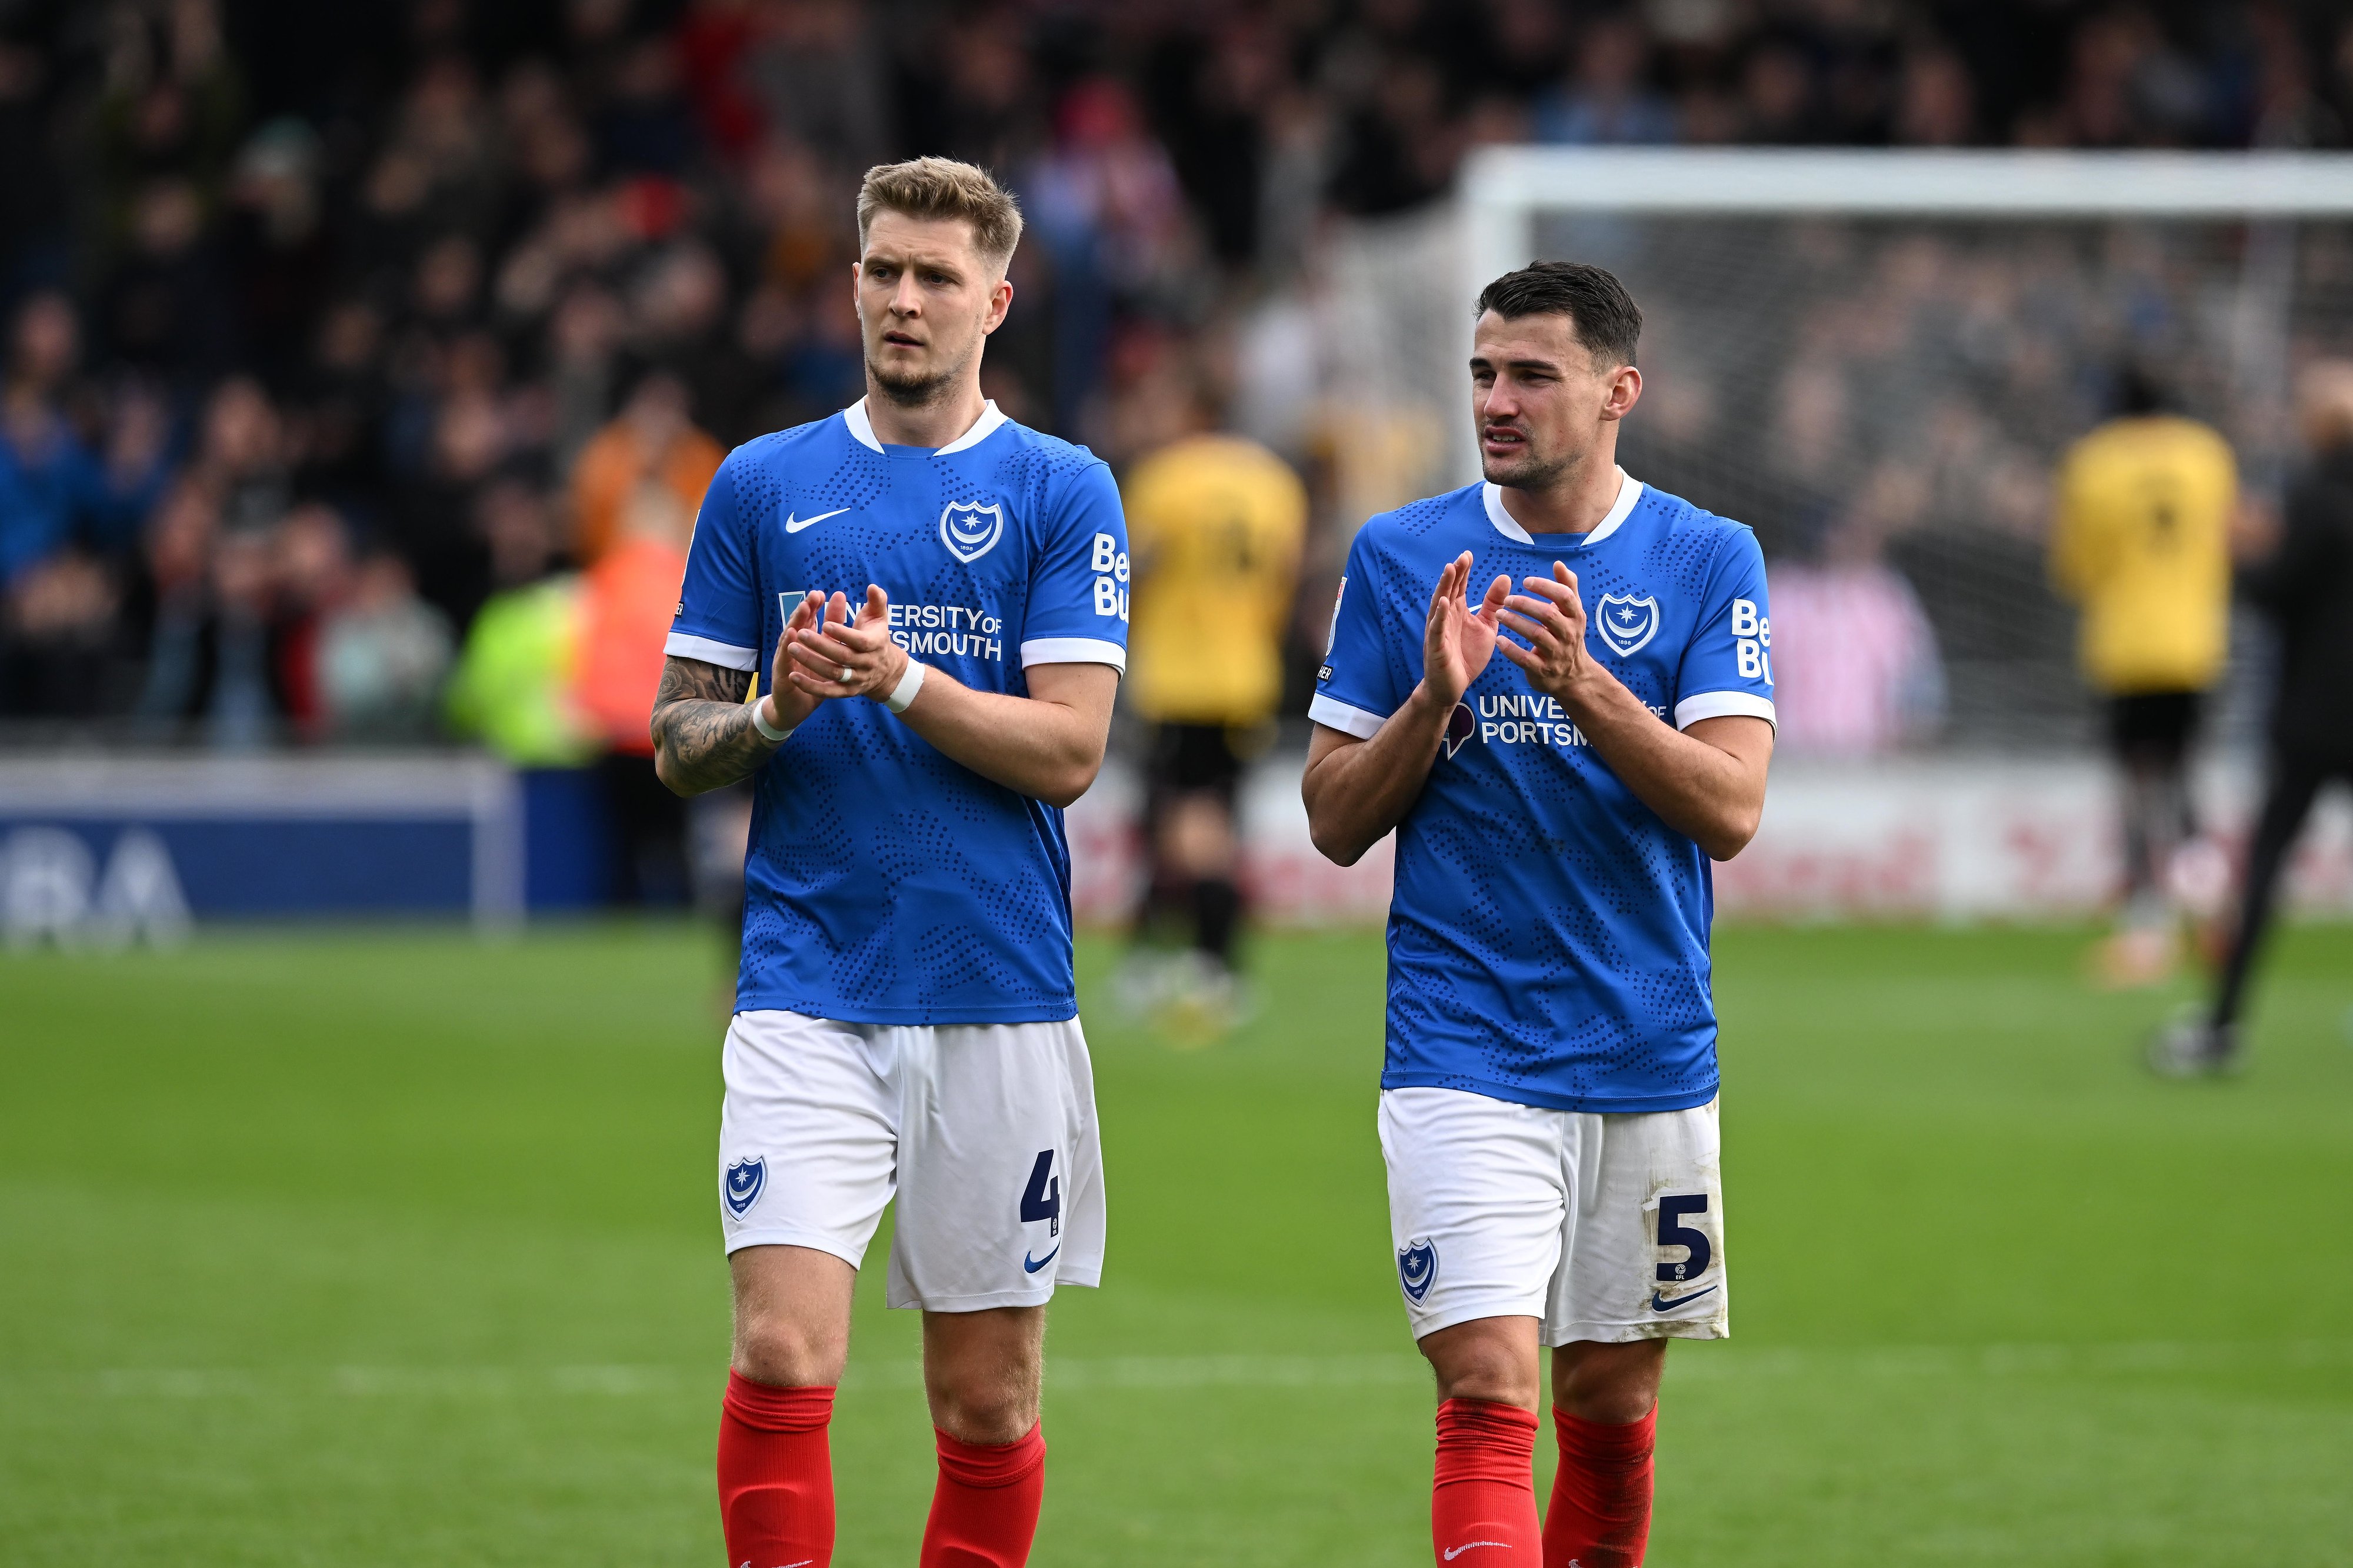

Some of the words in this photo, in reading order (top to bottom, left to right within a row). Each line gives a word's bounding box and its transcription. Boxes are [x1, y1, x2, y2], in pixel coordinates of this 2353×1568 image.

[824, 602, 984, 630] NERSITY
[982, 616, 1002, 635] OF
[888, 630, 1002, 662] SMOUTH
[1020, 1149, 1060, 1238] 4
[1656, 1193, 1711, 1282] 5
